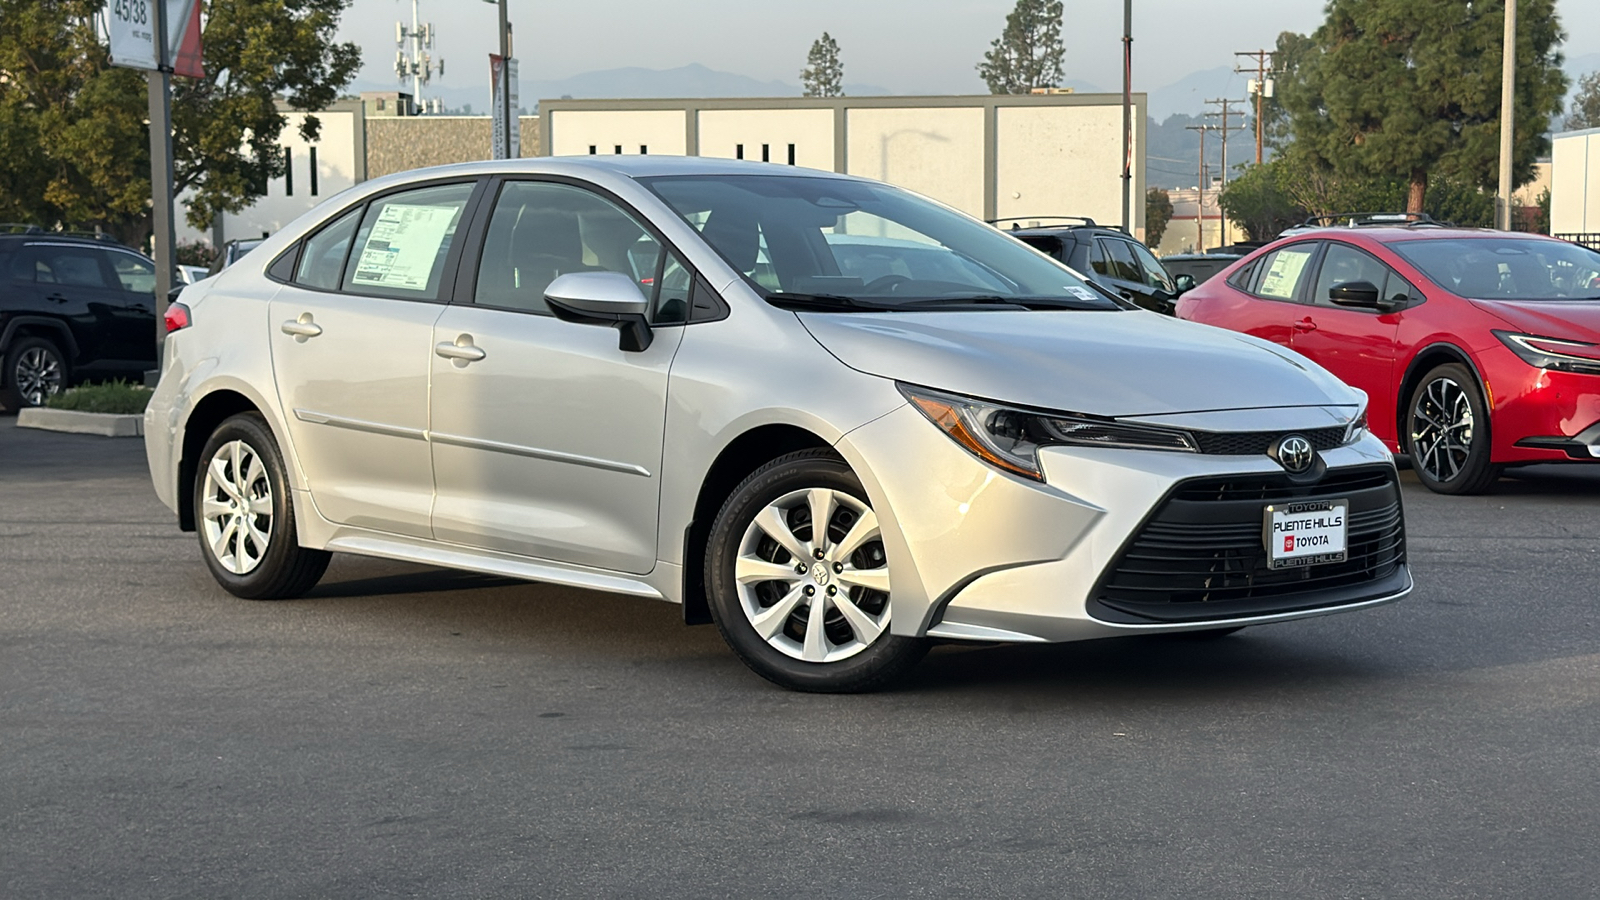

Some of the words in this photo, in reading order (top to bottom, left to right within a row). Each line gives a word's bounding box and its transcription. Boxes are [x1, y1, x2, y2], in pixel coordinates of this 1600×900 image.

[115, 0, 147, 25] 45/38
[1290, 502, 1329, 511] TOYOTA
[1274, 519, 1312, 532] PUENTE
[1313, 516, 1342, 528] HILLS
[1296, 535, 1329, 547] TOYOTA
[1275, 556, 1313, 568] PUENTE
[1315, 553, 1343, 563] HILLS
